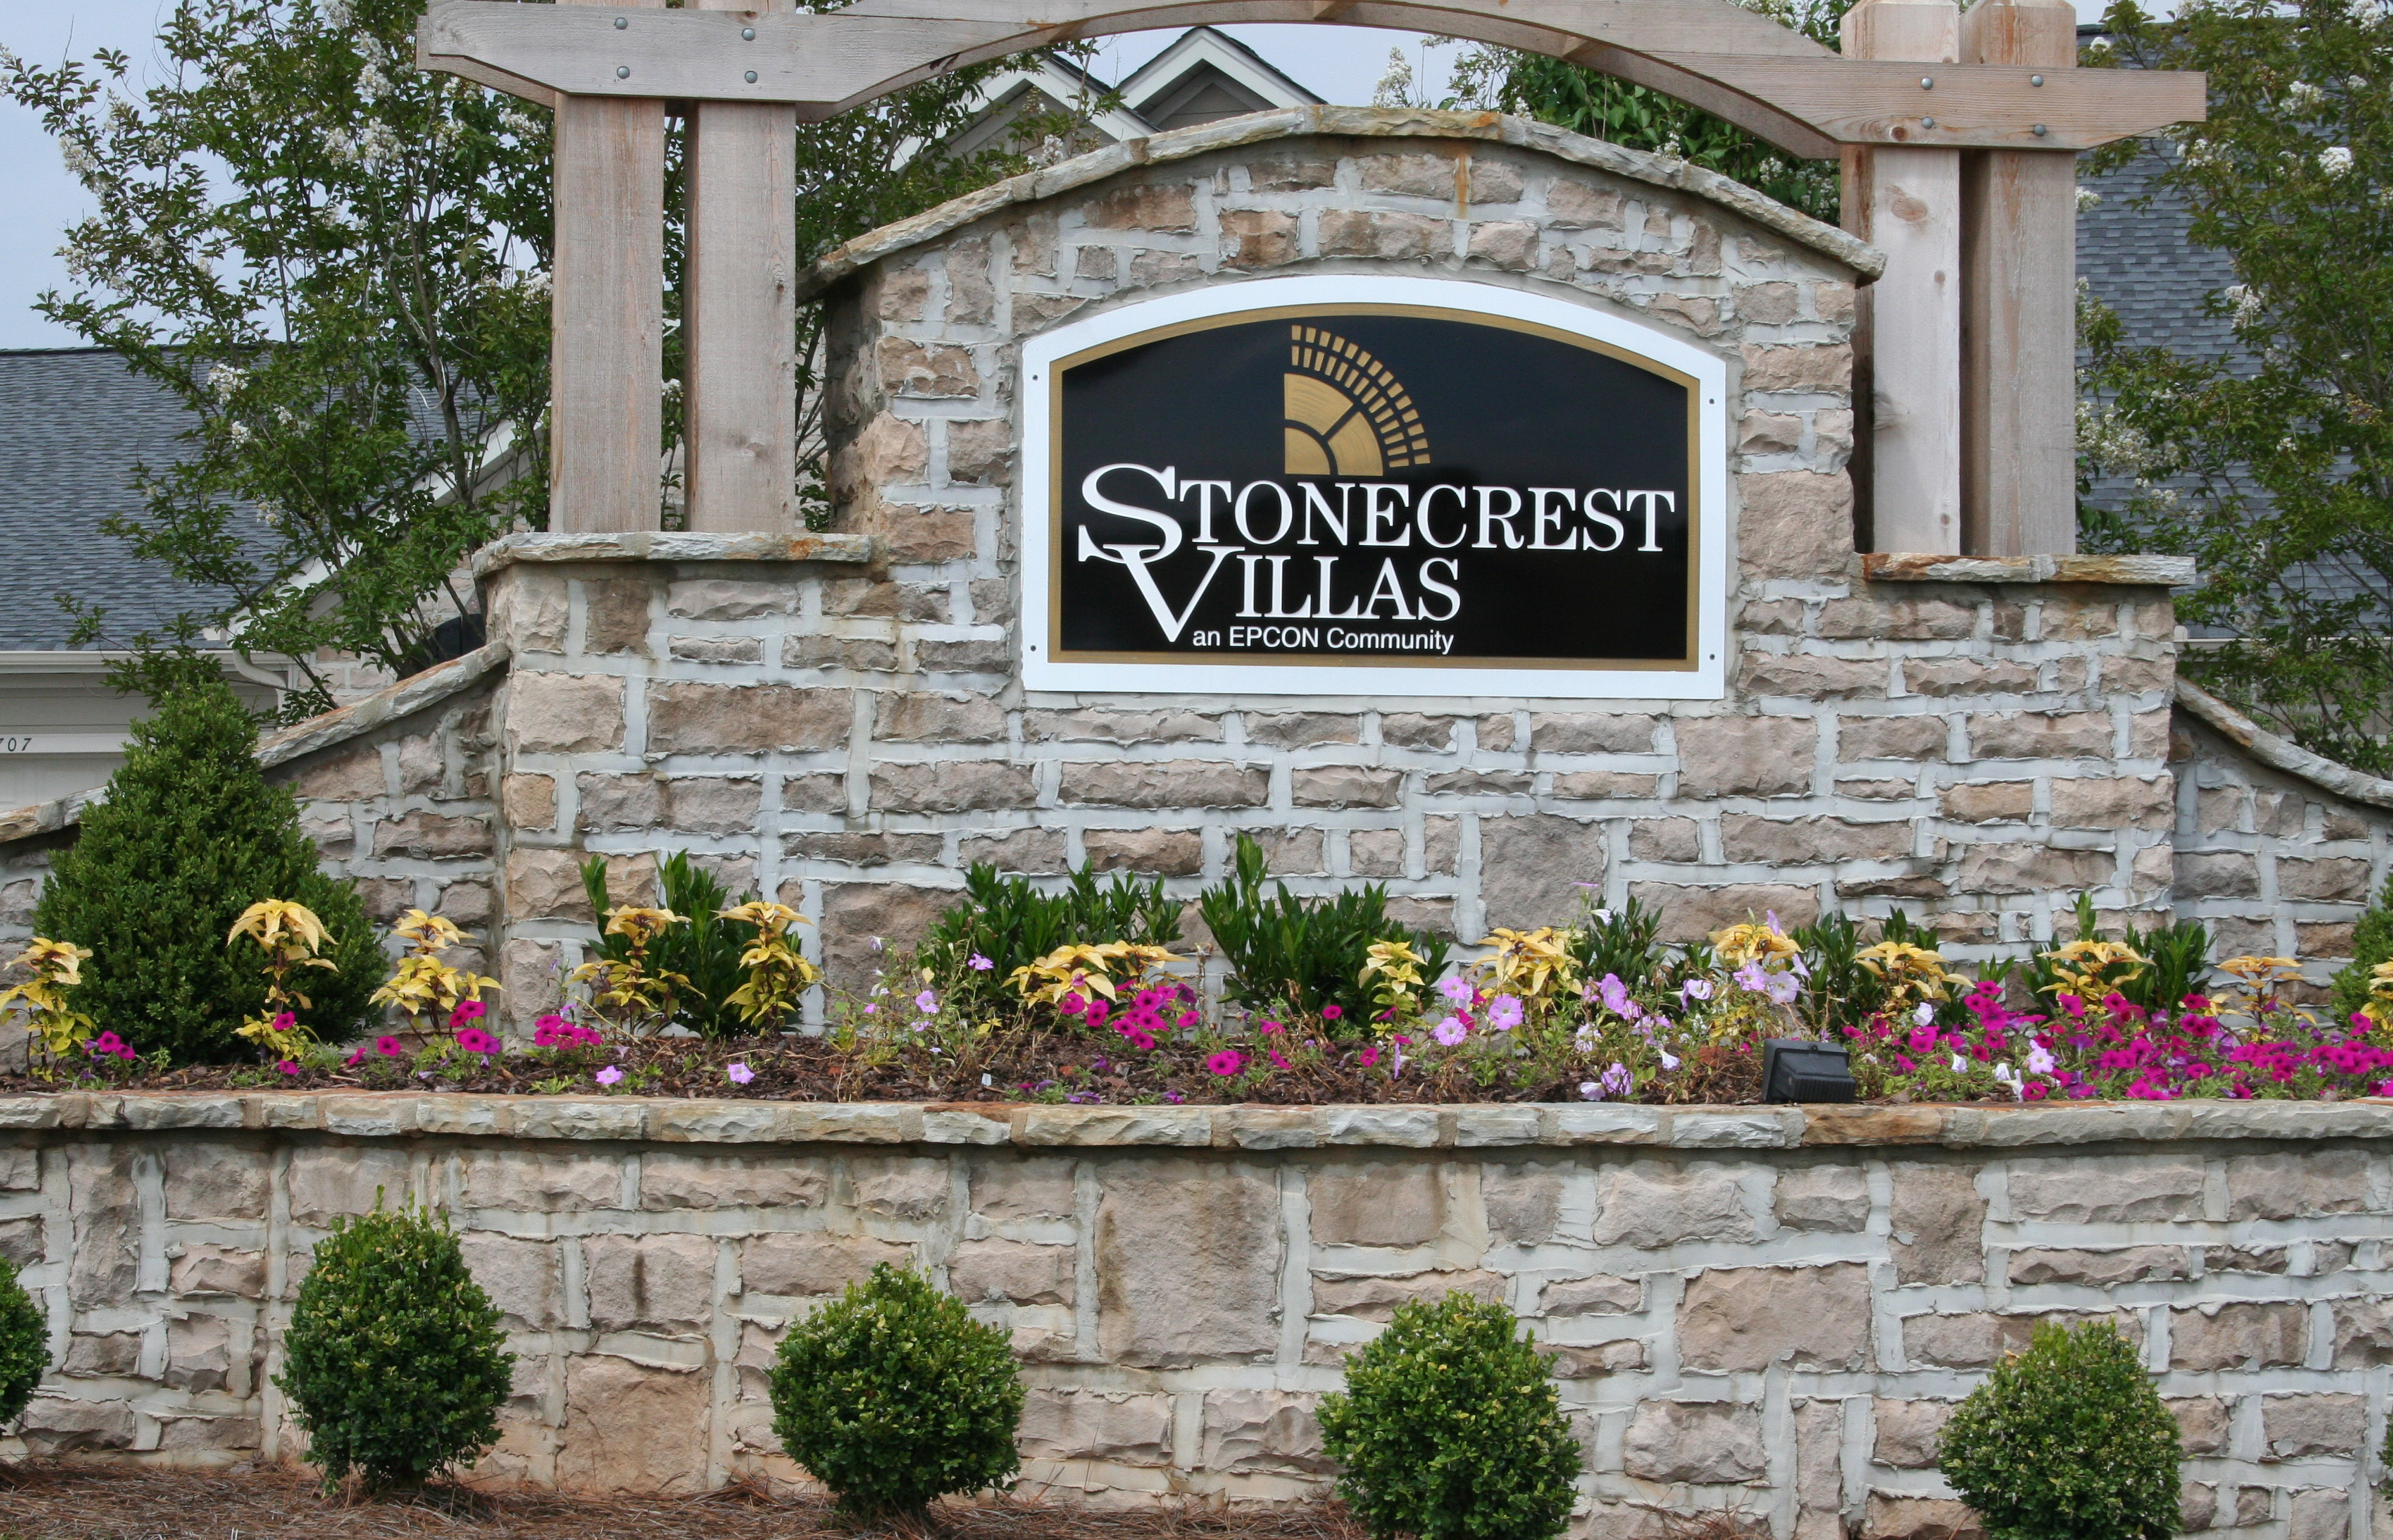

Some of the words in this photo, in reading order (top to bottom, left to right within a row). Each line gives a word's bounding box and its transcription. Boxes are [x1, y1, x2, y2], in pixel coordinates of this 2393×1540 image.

[1078, 463, 1675, 562] STONECREST
[1102, 544, 1461, 642] VILLAS
[1192, 630, 1221, 647] an
[1229, 626, 1319, 648] EPCON
[1326, 627, 1454, 655] Community
